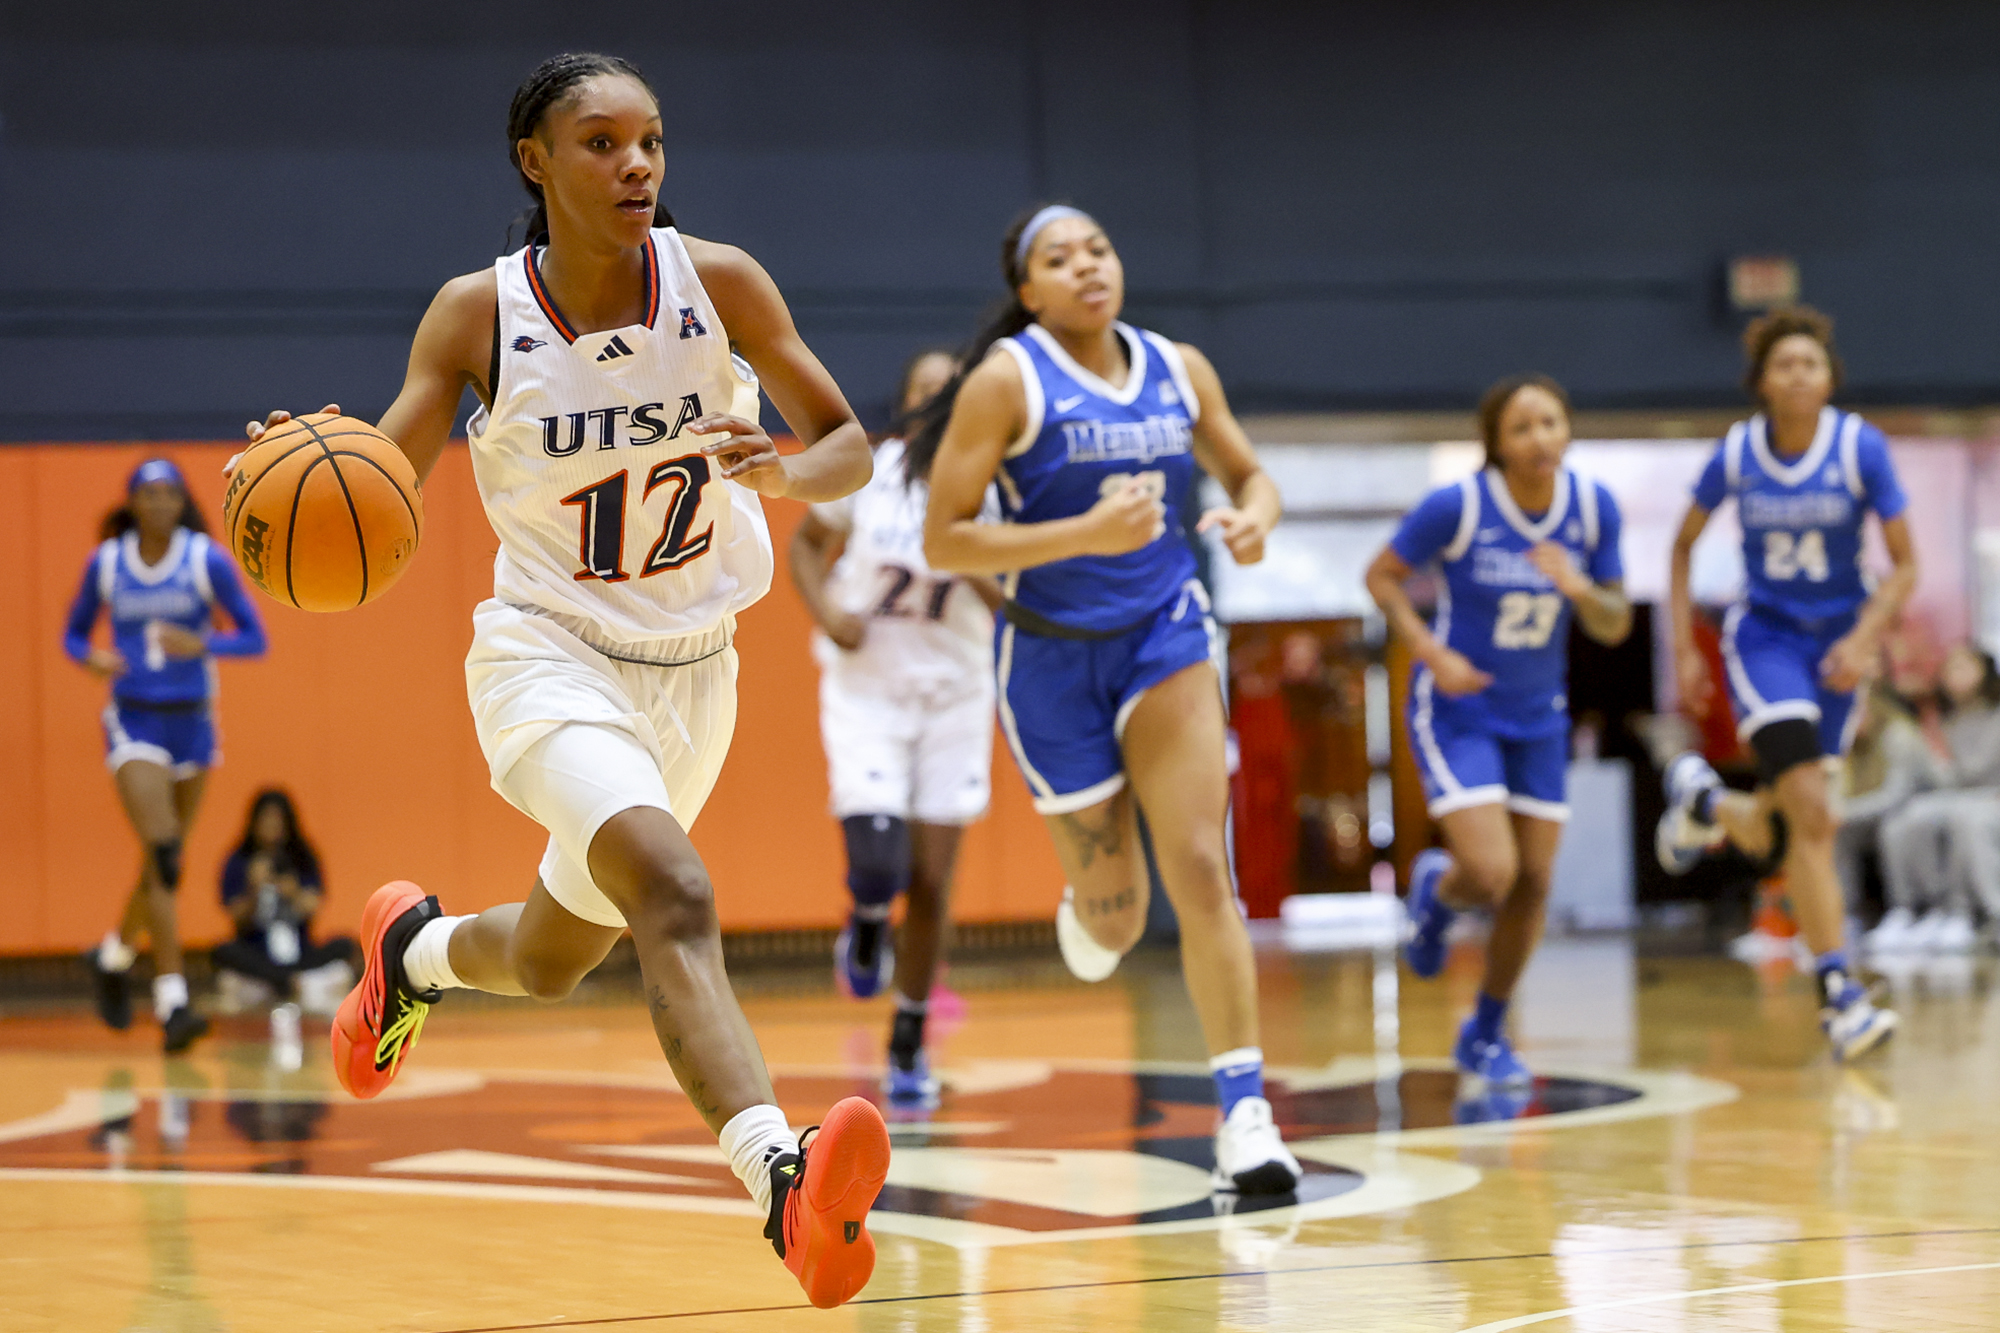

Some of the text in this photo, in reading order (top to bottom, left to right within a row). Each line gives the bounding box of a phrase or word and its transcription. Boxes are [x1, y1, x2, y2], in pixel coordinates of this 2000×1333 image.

[679, 307, 706, 340] A
[539, 392, 704, 458] UTSA
[1062, 414, 1193, 464] Memphis
[560, 453, 714, 583] 12
[1763, 530, 1829, 583] 24
[873, 564, 953, 622] 21
